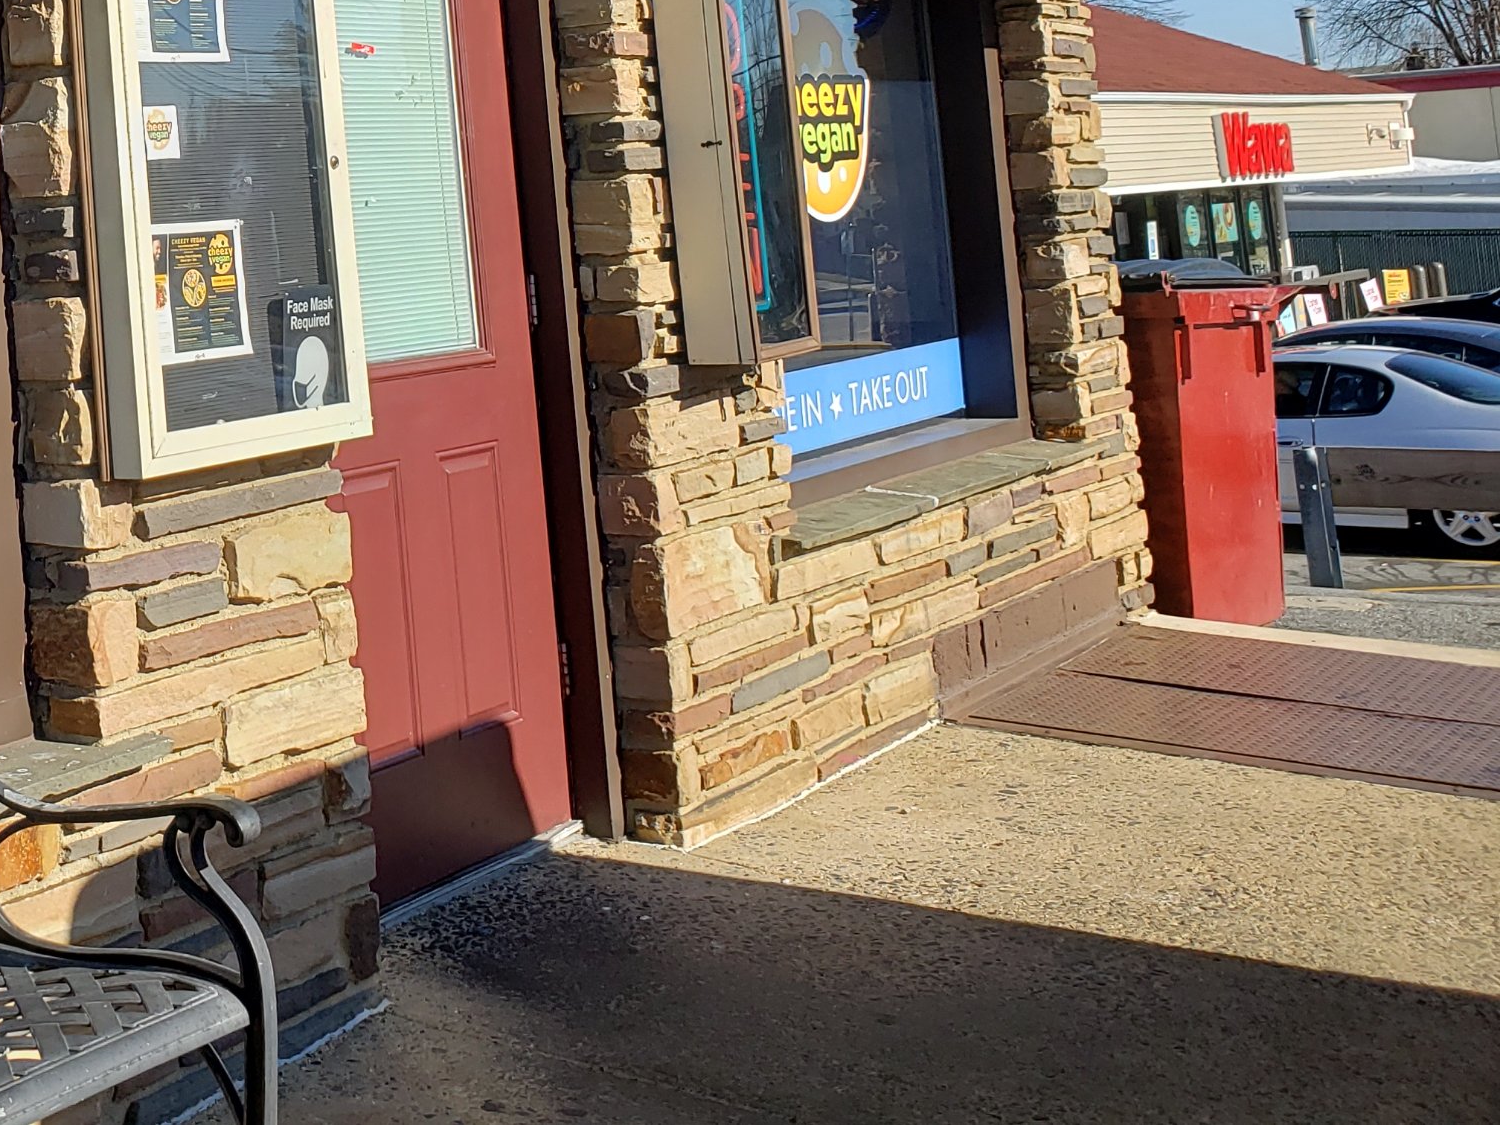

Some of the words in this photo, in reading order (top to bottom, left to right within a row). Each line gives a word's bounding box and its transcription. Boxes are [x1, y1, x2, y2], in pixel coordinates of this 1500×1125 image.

[1221, 111, 1294, 178] Wawa
[287, 299, 309, 315] Face
[310, 295, 334, 312] Mask
[290, 311, 331, 332] Required
[800, 389, 823, 428] IN
[848, 375, 893, 415] TAKE
[895, 366, 928, 404] OUT
